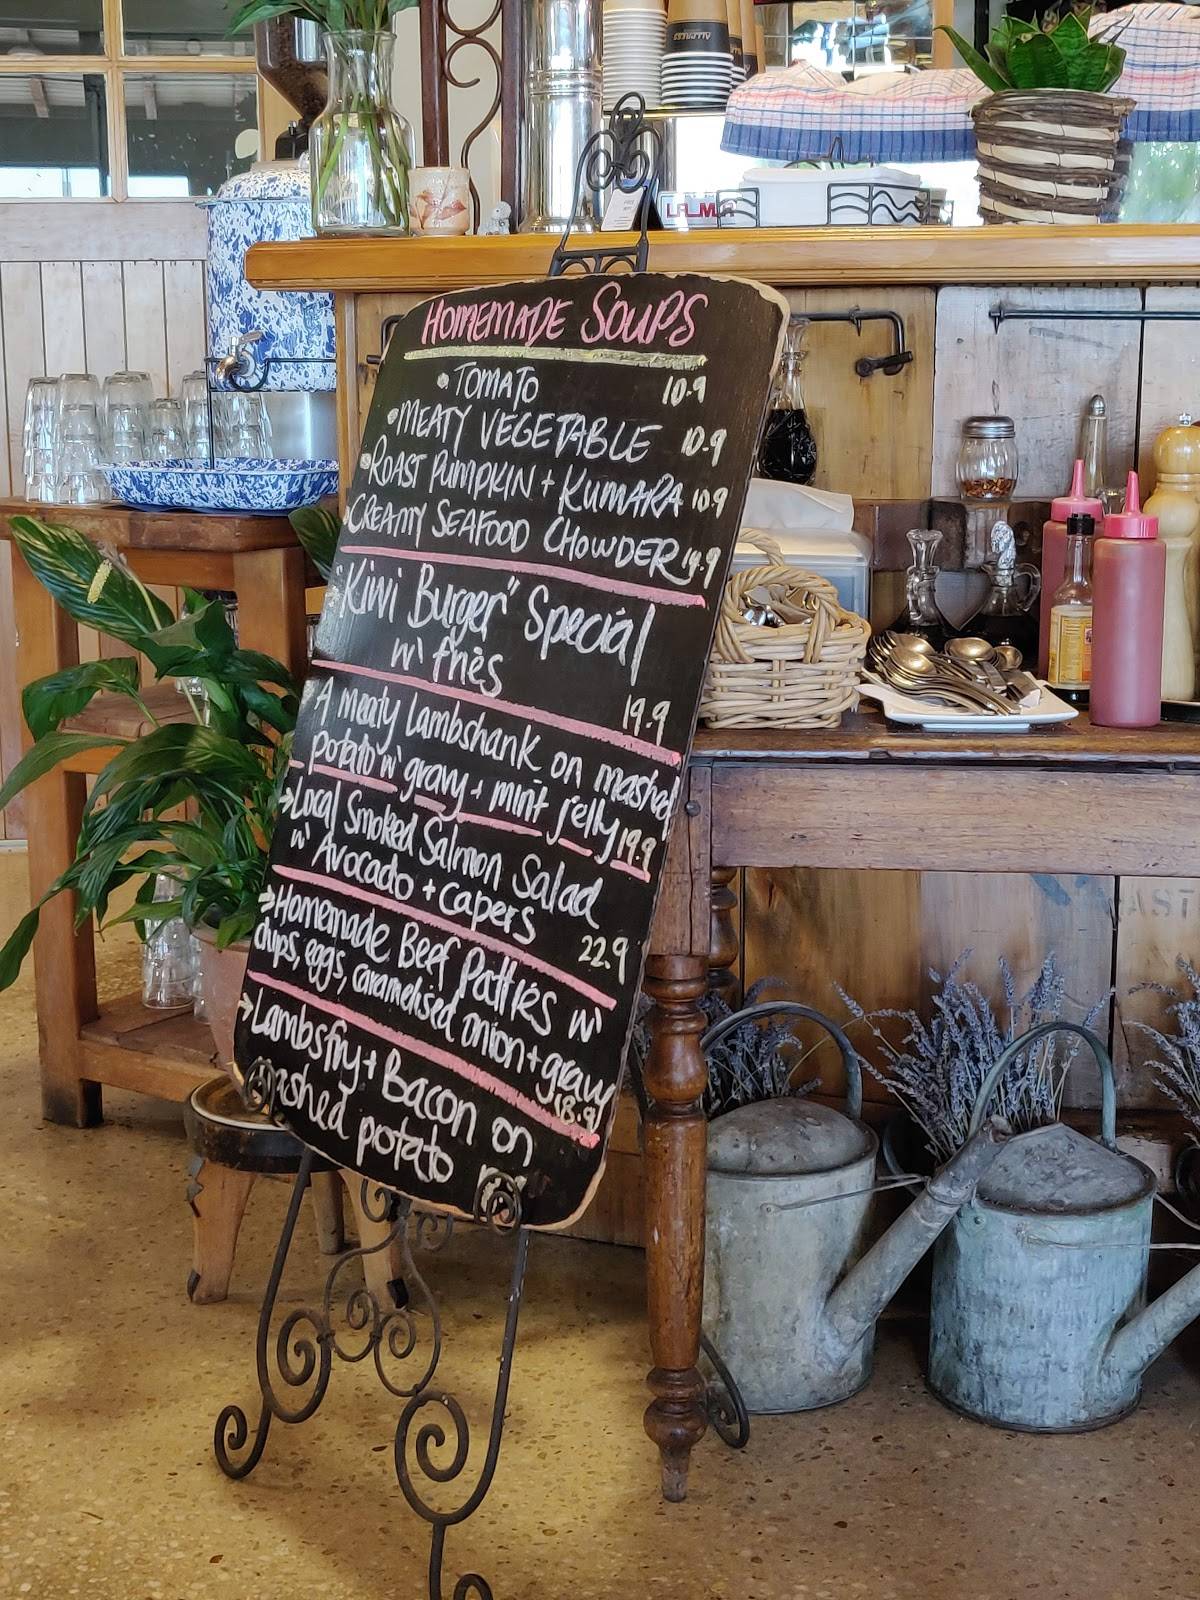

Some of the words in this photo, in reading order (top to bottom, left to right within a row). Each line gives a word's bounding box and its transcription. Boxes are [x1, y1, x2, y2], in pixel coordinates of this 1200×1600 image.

[421, 297, 573, 346] HOMEMADE
[581, 281, 708, 347] SOUPS
[395, 399, 470, 457] MEATY
[481, 409, 663, 464] VEGETABLE
[681, 428, 727, 467] 10.9
[454, 362, 539, 411] TOMATO
[661, 376, 706, 407] 10.9
[368, 434, 427, 488] ROAST
[428, 453, 534, 500] PUMPKIN
[541, 478, 556, 497] +
[558, 472, 683, 518] KUMARA
[691, 488, 728, 518] 10.9
[346, 492, 427, 548] CREAMY
[432, 499, 529, 553] SEAFOOD
[543, 516, 691, 586] CHOWDER
[524, 584, 656, 686] Special
[433, 635, 503, 698] fries
[623, 694, 671, 745] 19.9
[314, 676, 334, 724] A
[338, 685, 401, 753] meaty
[550, 752, 582, 788] on
[594, 763, 680, 841] mashed
[290, 776, 341, 834] Local
[344, 789, 418, 857] Smoked
[419, 815, 501, 890] Salmon
[512, 854, 603, 929] Salad
[399, 760, 469, 821] gravy
[489, 779, 548, 823] mint
[617, 827, 657, 872] 19.9
[274, 883, 391, 964] Homemade
[398, 922, 461, 992] Beef
[460, 947, 558, 1037] Patties
[311, 831, 413, 900] Avocado
[578, 935, 629, 984] 22.9
[352, 962, 460, 1043] caramelised
[535, 1053, 616, 1134] gravy
[356, 1114, 453, 1183] potato
[382, 1049, 477, 1144] Bacon
[492, 1118, 533, 1167] on
[554, 1094, 596, 1134] 18.9
